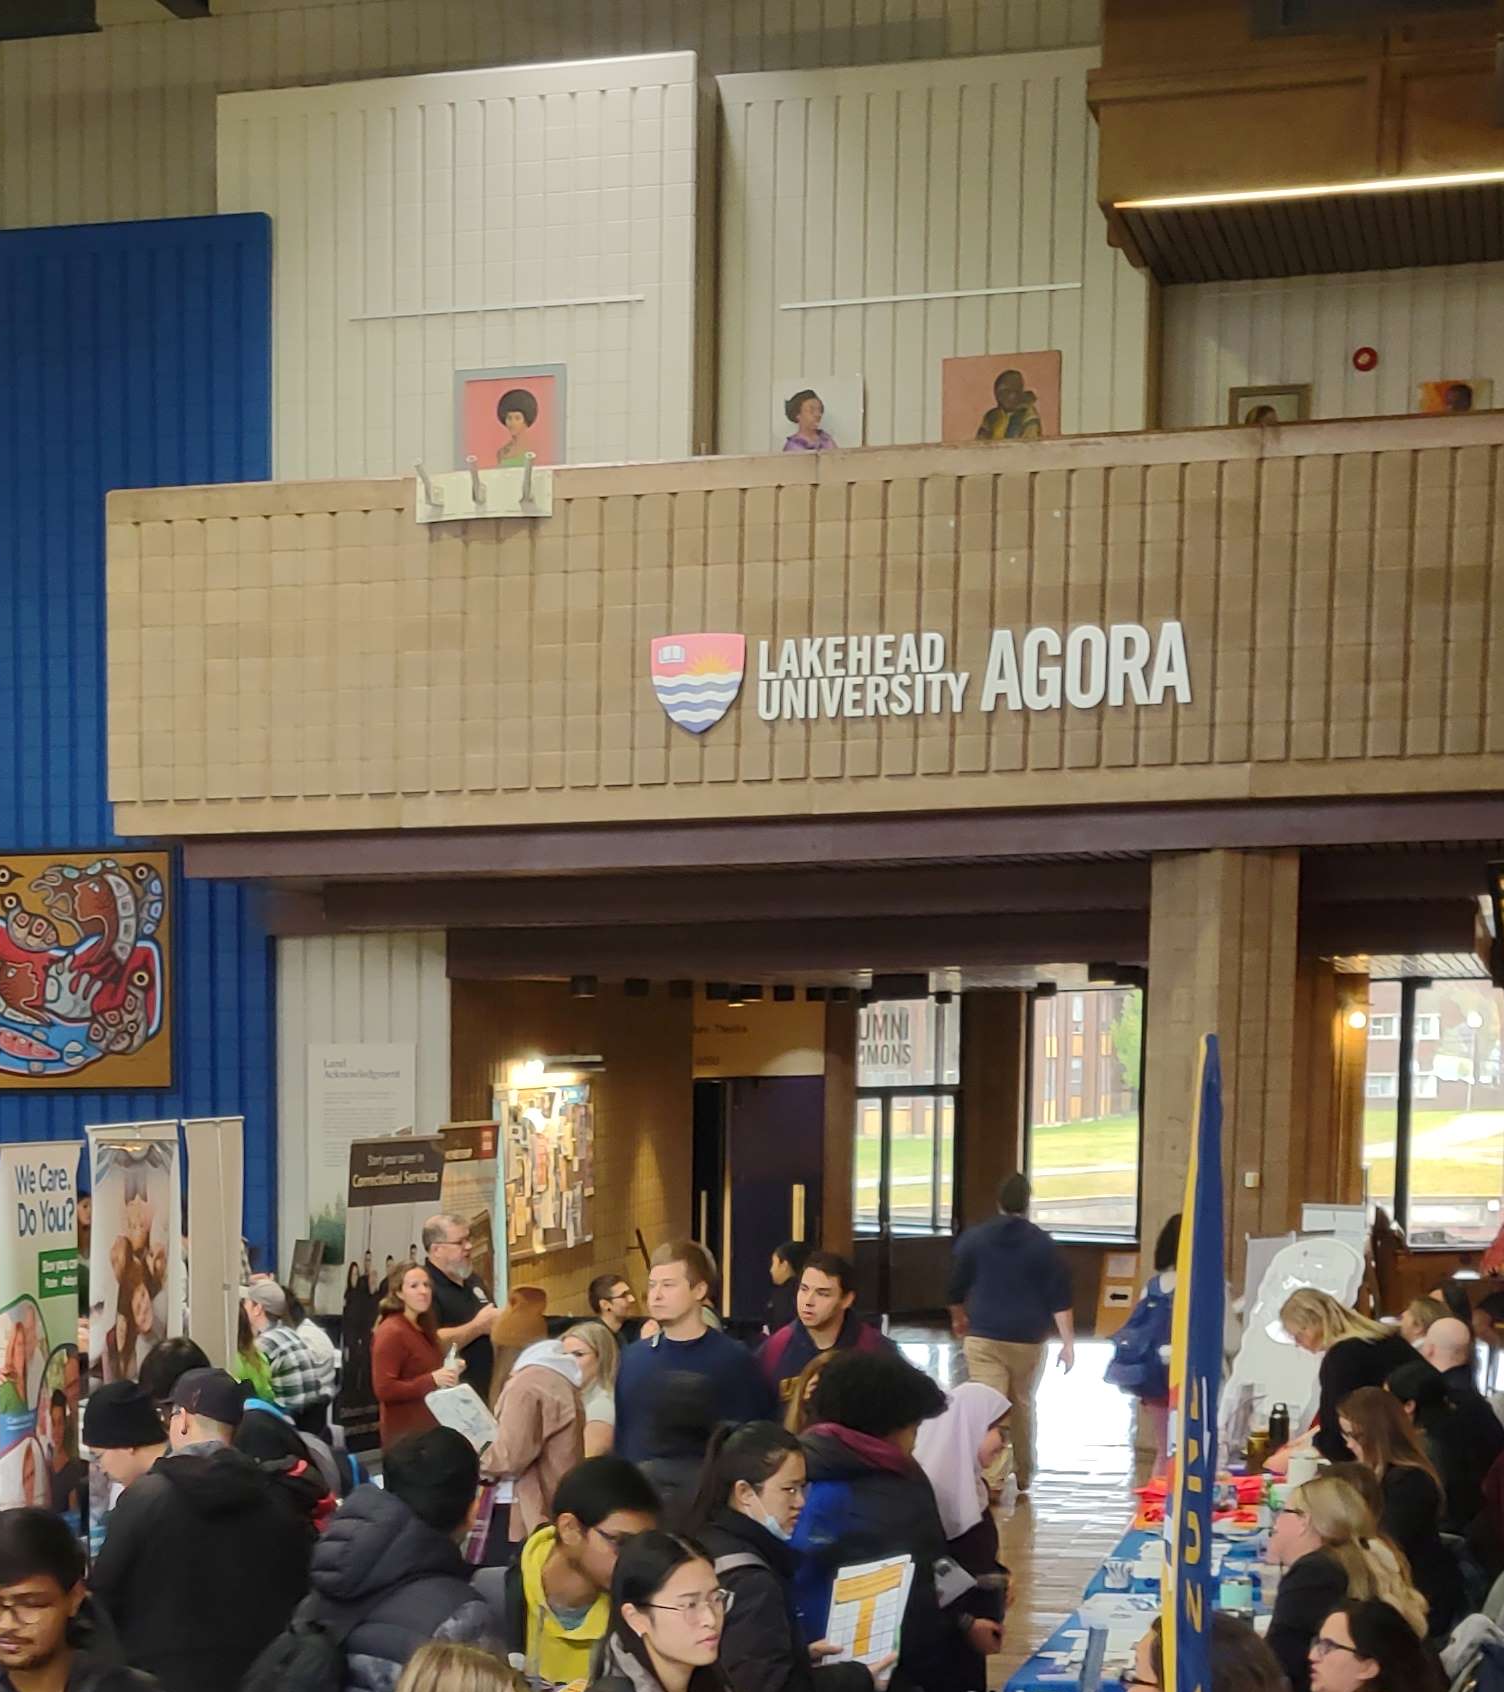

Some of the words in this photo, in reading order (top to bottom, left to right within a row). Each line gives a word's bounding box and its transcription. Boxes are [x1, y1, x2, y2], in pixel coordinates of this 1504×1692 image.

[757, 631, 945, 681] LAKEHEAD
[979, 620, 1193, 713] AGORA
[757, 671, 971, 722] UNIVERSITY
[15, 1164, 36, 1195] We
[18, 1203, 37, 1238] Do
[40, 1198, 75, 1234] You?
